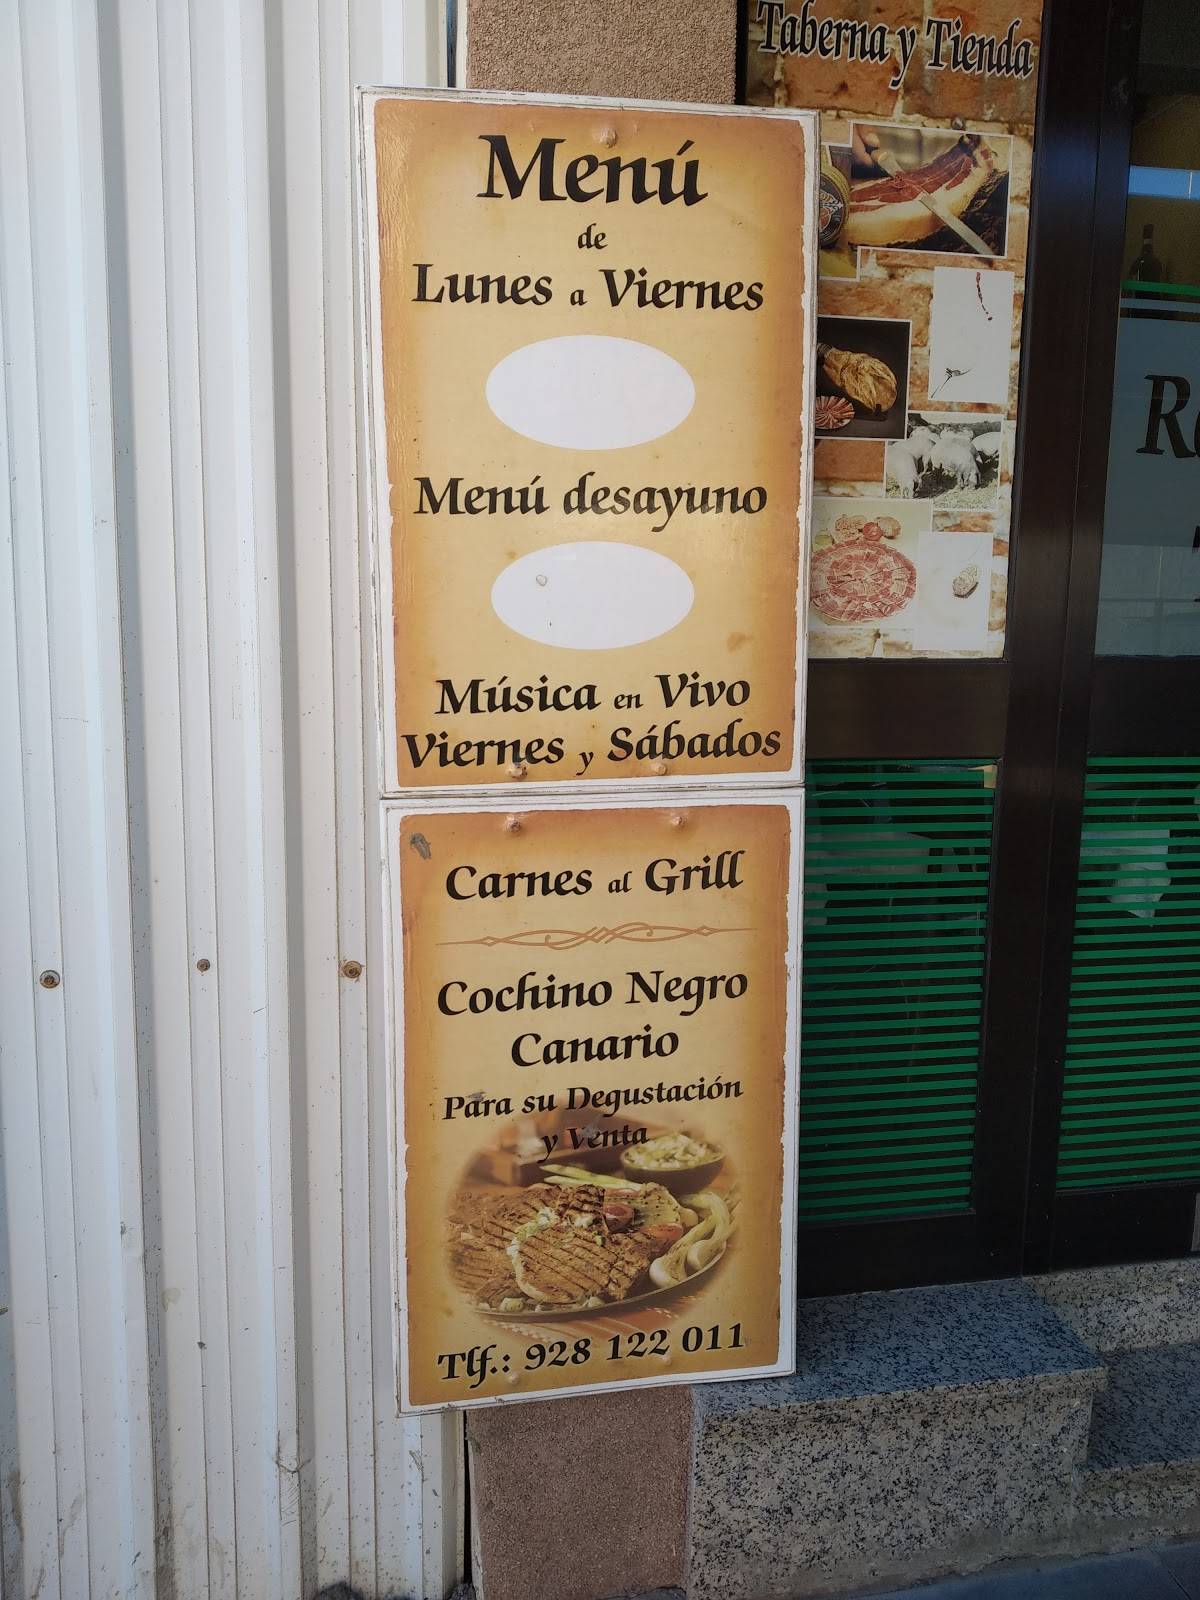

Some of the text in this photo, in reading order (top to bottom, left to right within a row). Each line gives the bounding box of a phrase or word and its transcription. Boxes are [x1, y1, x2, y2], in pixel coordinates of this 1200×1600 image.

[757, 0, 1034, 90] Taberna y Tienda
[476, 135, 708, 207] Menú
[577, 223, 608, 250] de
[411, 263, 764, 311] Lunes a Viernes
[413, 472, 768, 532] Menú desayuno
[434, 671, 751, 714] Música en Vivo
[400, 718, 781, 776] Viernes y Sábados
[446, 850, 746, 900] Carnes al Grill
[437, 969, 749, 1016] Cochino Negro
[511, 1023, 680, 1067] Canario
[442, 1075, 744, 1120] Para su Degustación
[536, 1123, 650, 1163] y Venta
[438, 1322, 746, 1389] Tlf.: 928 122 011
